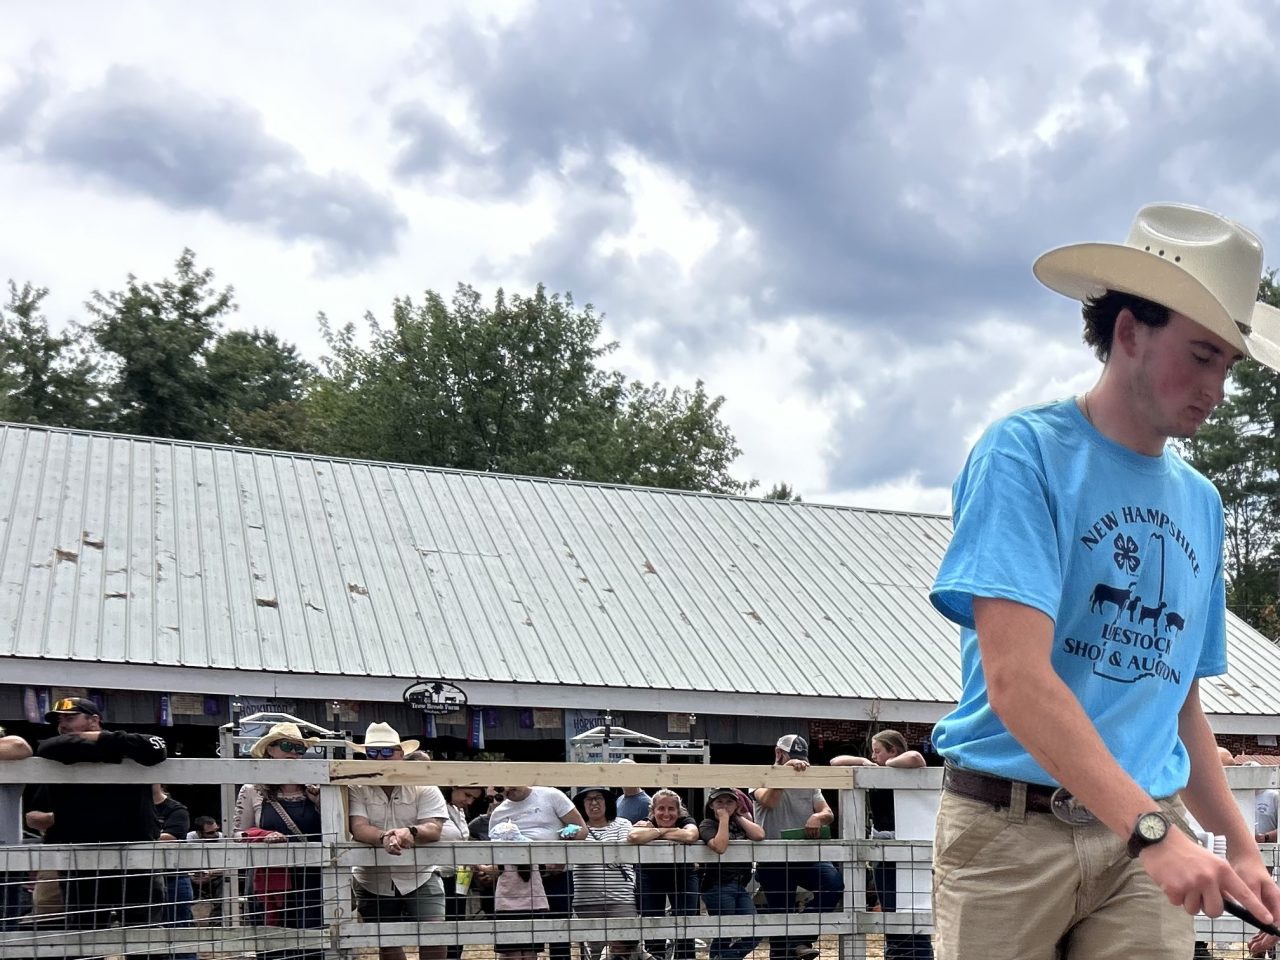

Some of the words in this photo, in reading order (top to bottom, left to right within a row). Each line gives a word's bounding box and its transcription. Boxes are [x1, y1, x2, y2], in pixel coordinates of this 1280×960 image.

[1080, 511, 1119, 551] NEW
[1122, 506, 1201, 578] HAMPSHIRE
[1063, 637, 1105, 662] SHO
[1108, 650, 1121, 667] &
